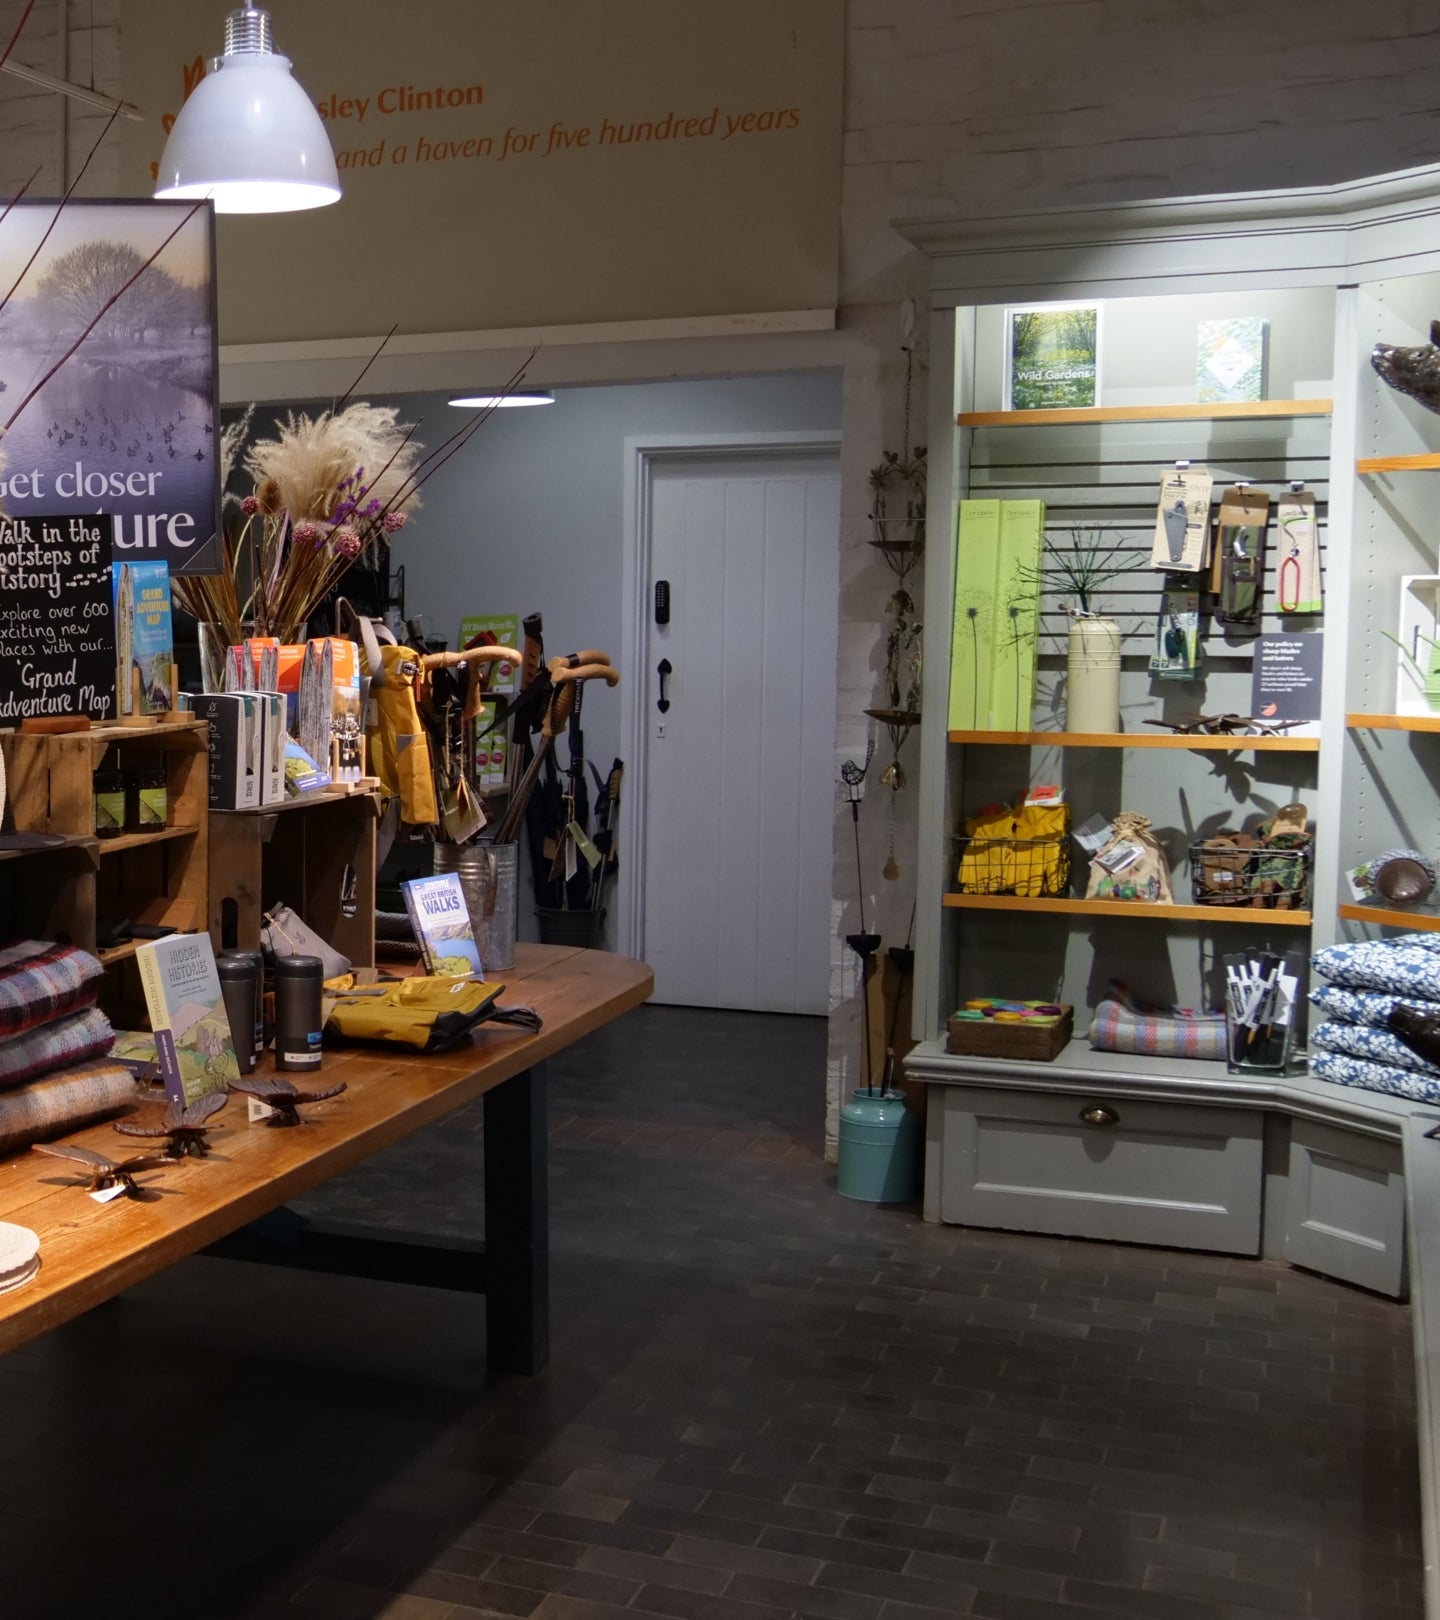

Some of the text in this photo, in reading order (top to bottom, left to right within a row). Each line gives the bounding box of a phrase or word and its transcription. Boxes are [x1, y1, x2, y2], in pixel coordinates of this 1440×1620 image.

[317, 85, 484, 122] sley Clinton
[336, 107, 801, 170] and a haven for five hundred years
[1017, 369, 1091, 381] Wild Gardens
[55, 461, 163, 498] closer
[42, 522, 63, 543] in
[69, 519, 101, 542] the
[112, 510, 197, 549] ure
[80, 543, 100, 564] of
[142, 588, 163, 600] GRAND
[48, 606, 76, 618] over
[83, 602, 109, 618] 600
[137, 601, 170, 614] ADVENTURE
[61, 624, 90, 635] new
[42, 639, 74, 654] with
[574, 677, 582, 713] TREKMATE
[420, 888, 458, 902] GREAT BRITISH
[422, 895, 460, 915] WALKS
[169, 944, 200, 965] HIDDEN
[168, 959, 209, 982] HISTORIES
